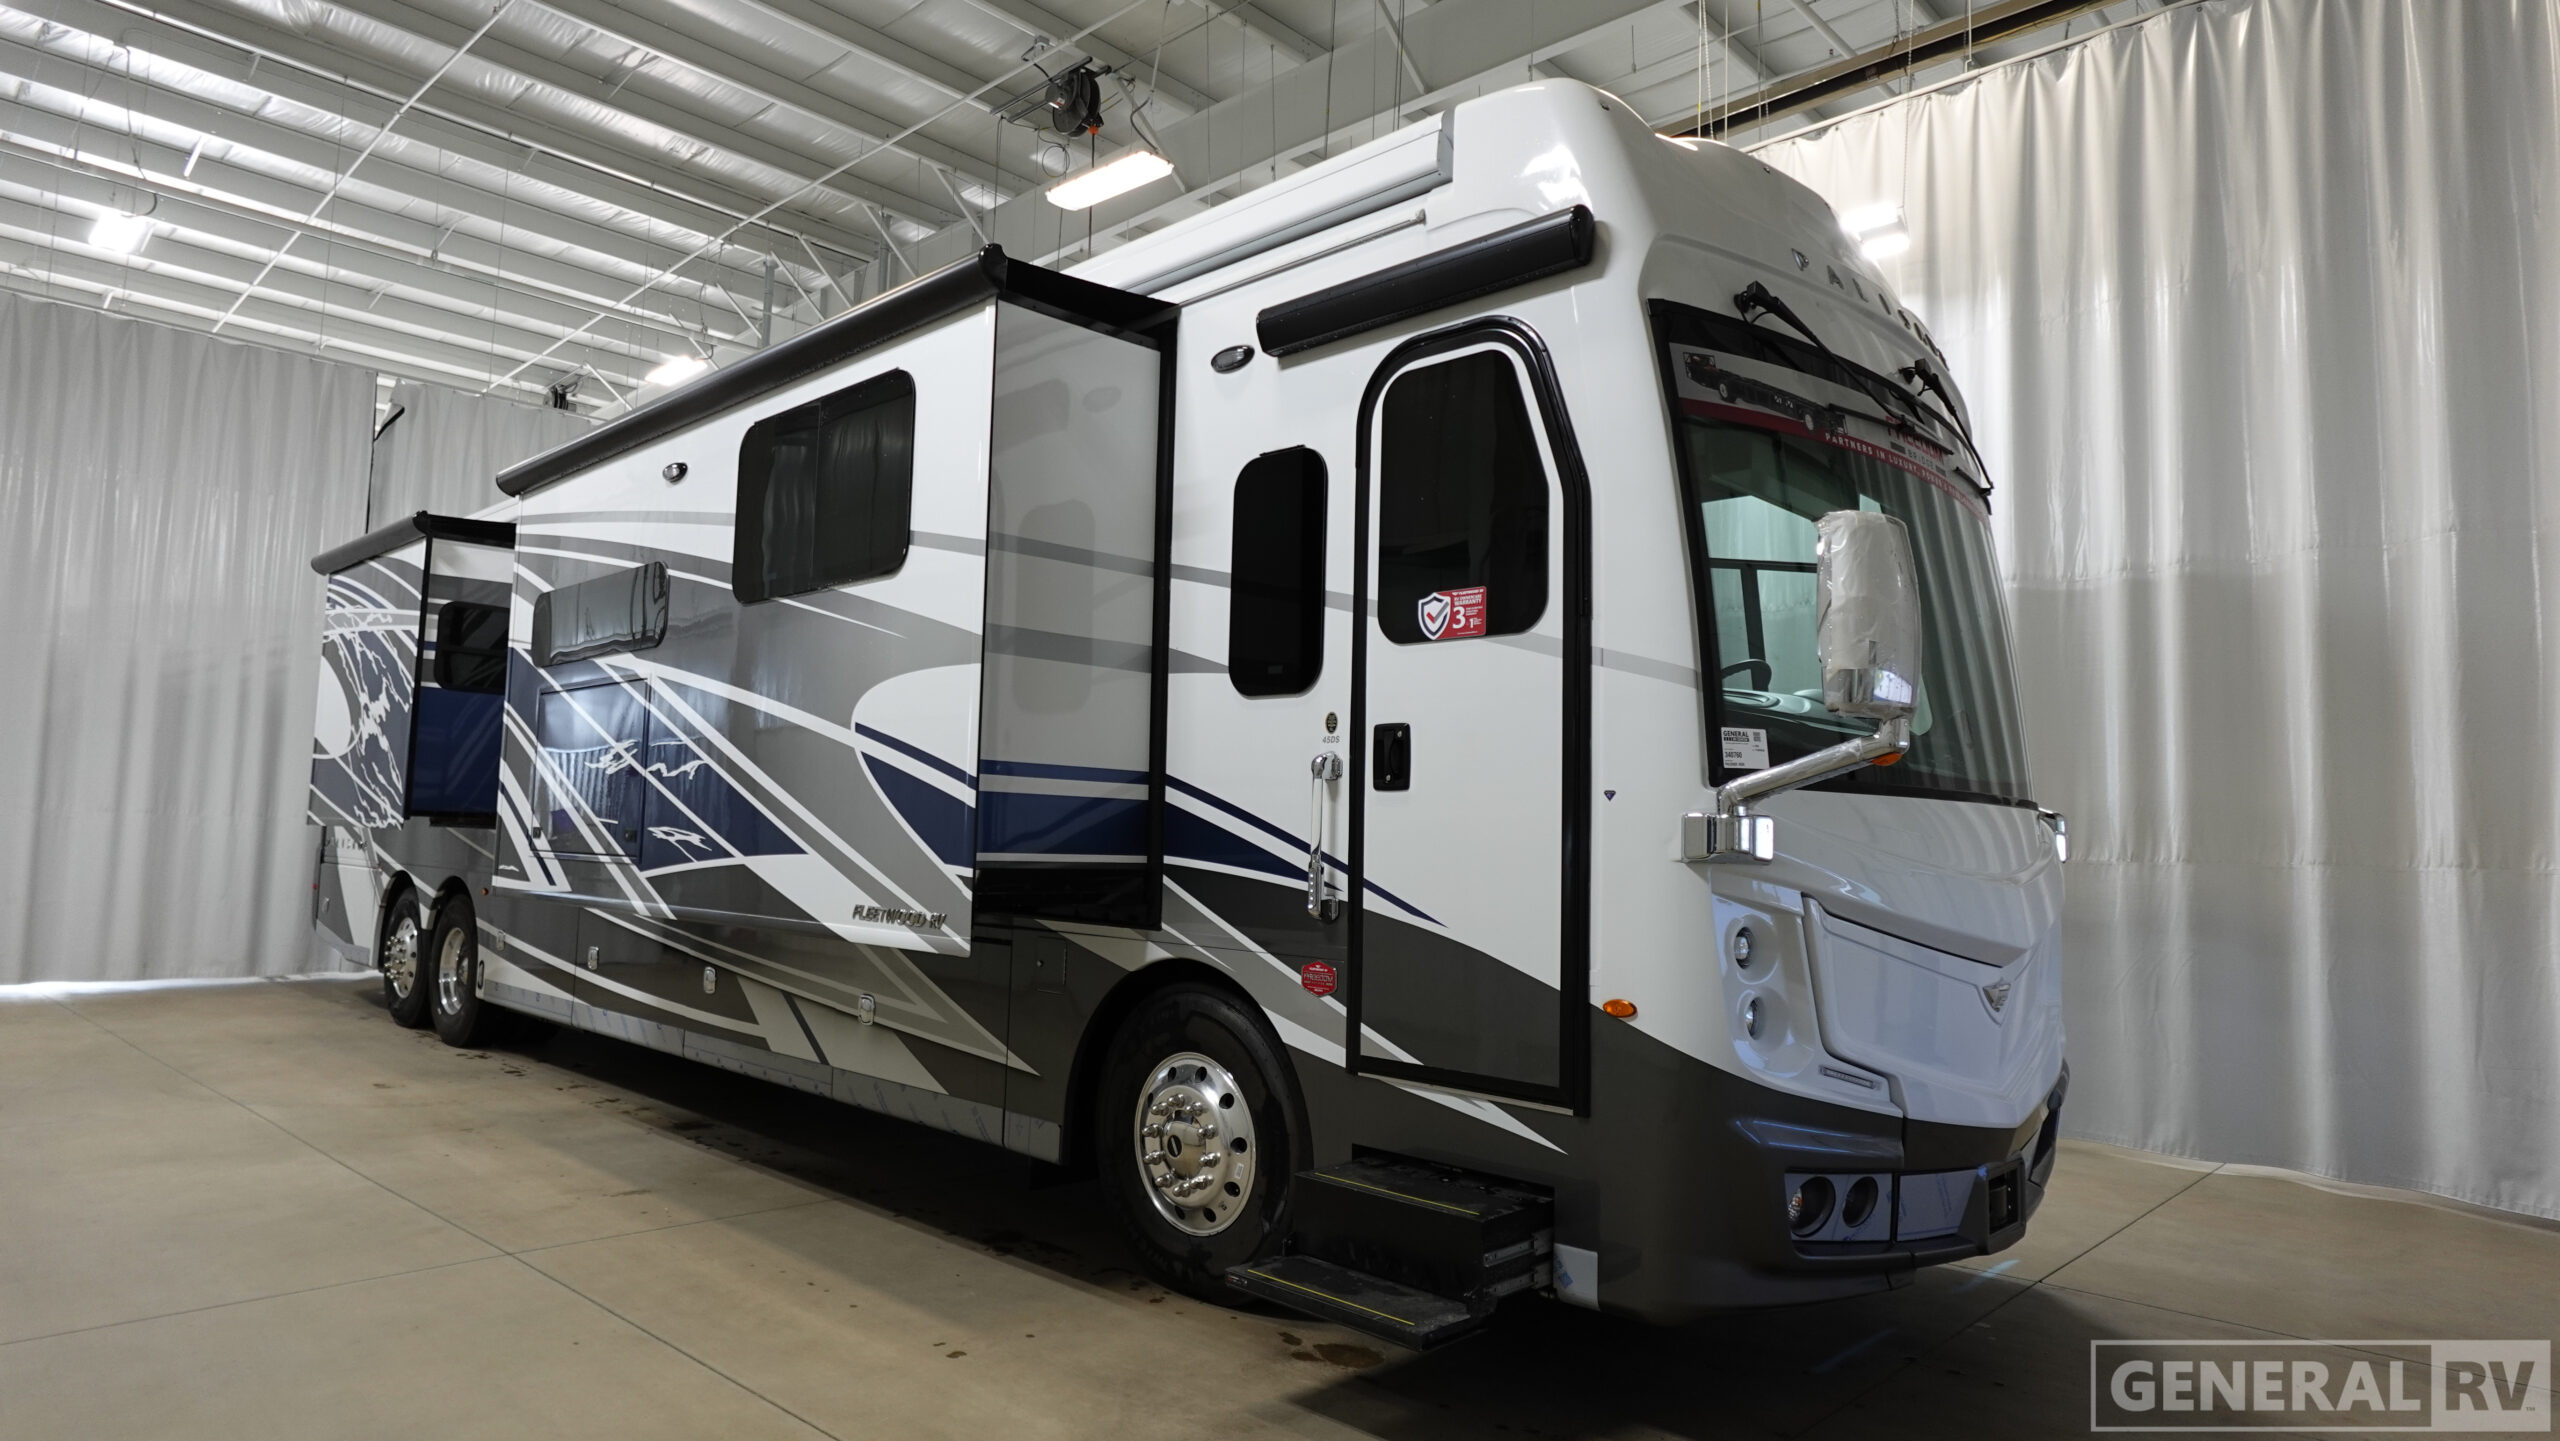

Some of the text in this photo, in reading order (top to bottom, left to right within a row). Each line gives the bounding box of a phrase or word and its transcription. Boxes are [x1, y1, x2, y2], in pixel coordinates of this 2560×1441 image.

[1825, 432, 1873, 454] PARTNERS
[1876, 449, 1886, 459] IN
[1452, 606, 1466, 629] 3
[1469, 618, 1474, 629] 1
[1322, 735, 1340, 744] 45DS
[852, 904, 947, 930] FLEETWOOD RV
